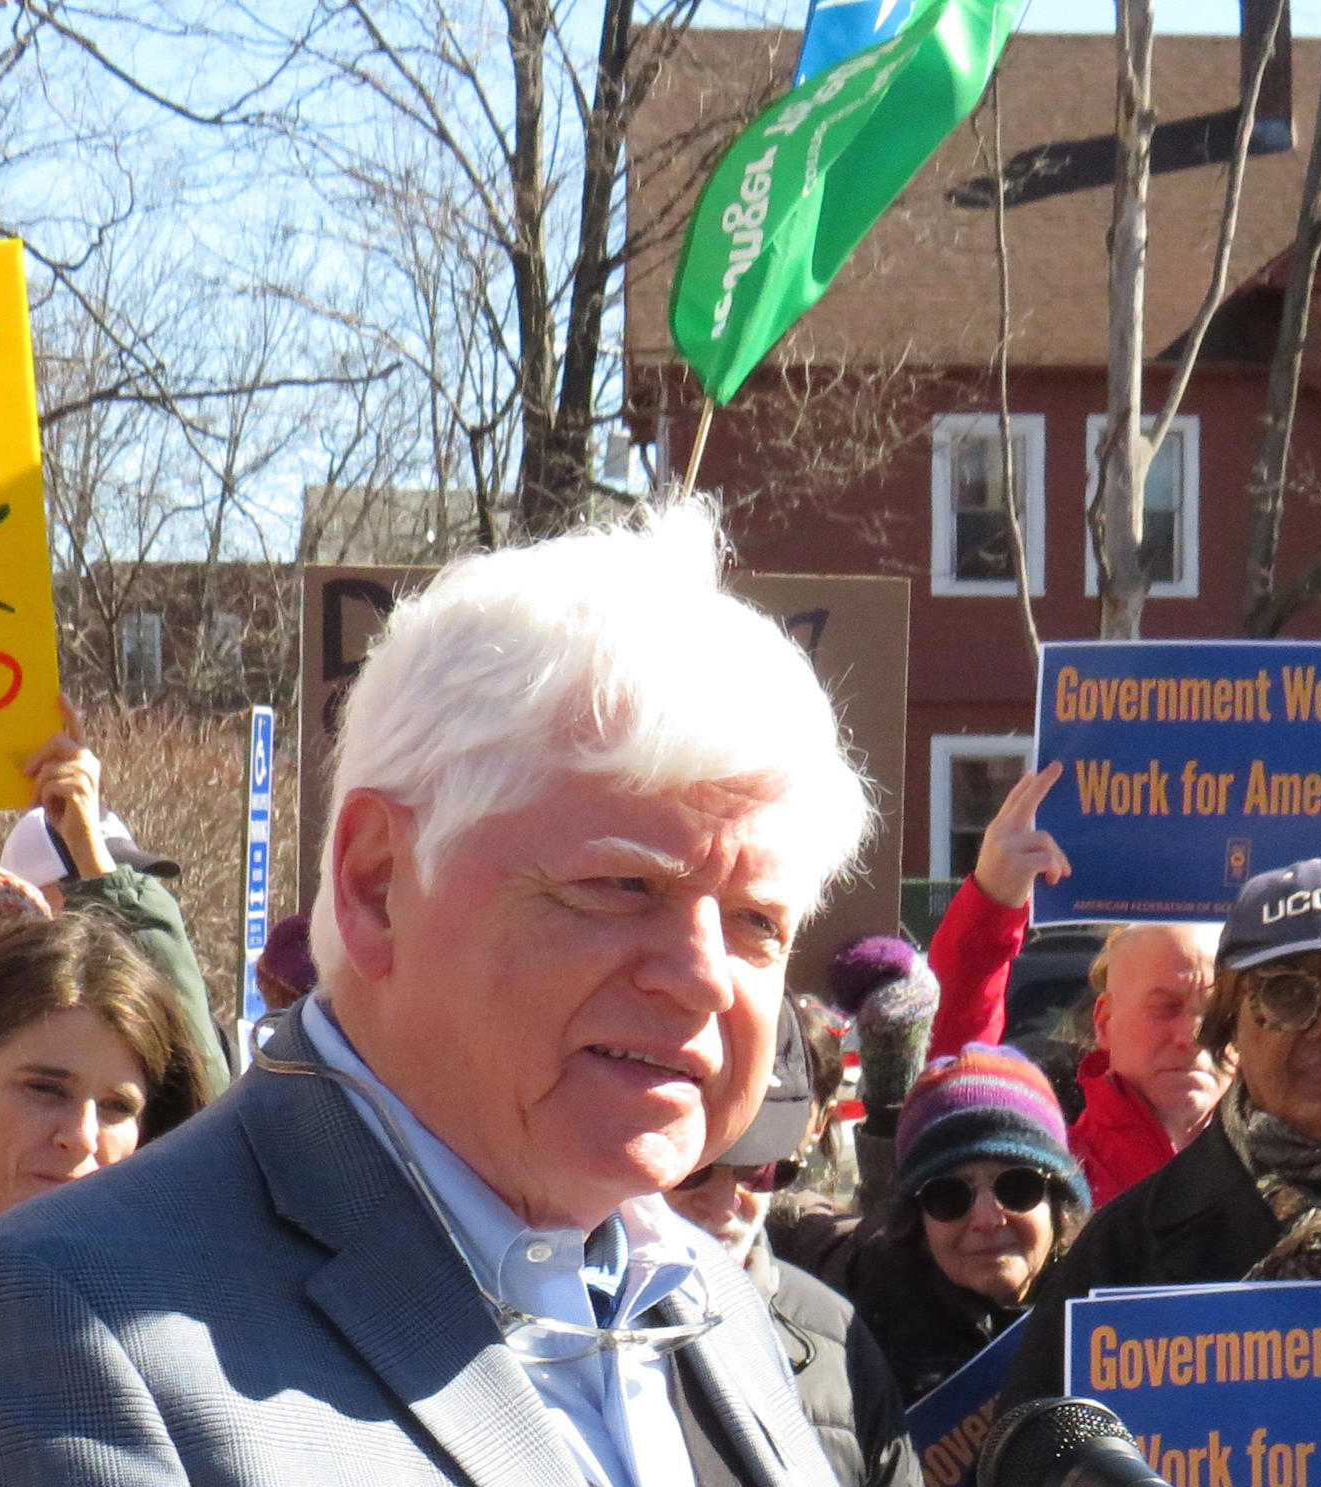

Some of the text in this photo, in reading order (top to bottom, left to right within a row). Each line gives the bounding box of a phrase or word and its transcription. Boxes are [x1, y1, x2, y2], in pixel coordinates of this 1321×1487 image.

[1055, 665, 1272, 723] Government
[1075, 760, 1169, 817] Work
[1181, 759, 1235, 816] for
